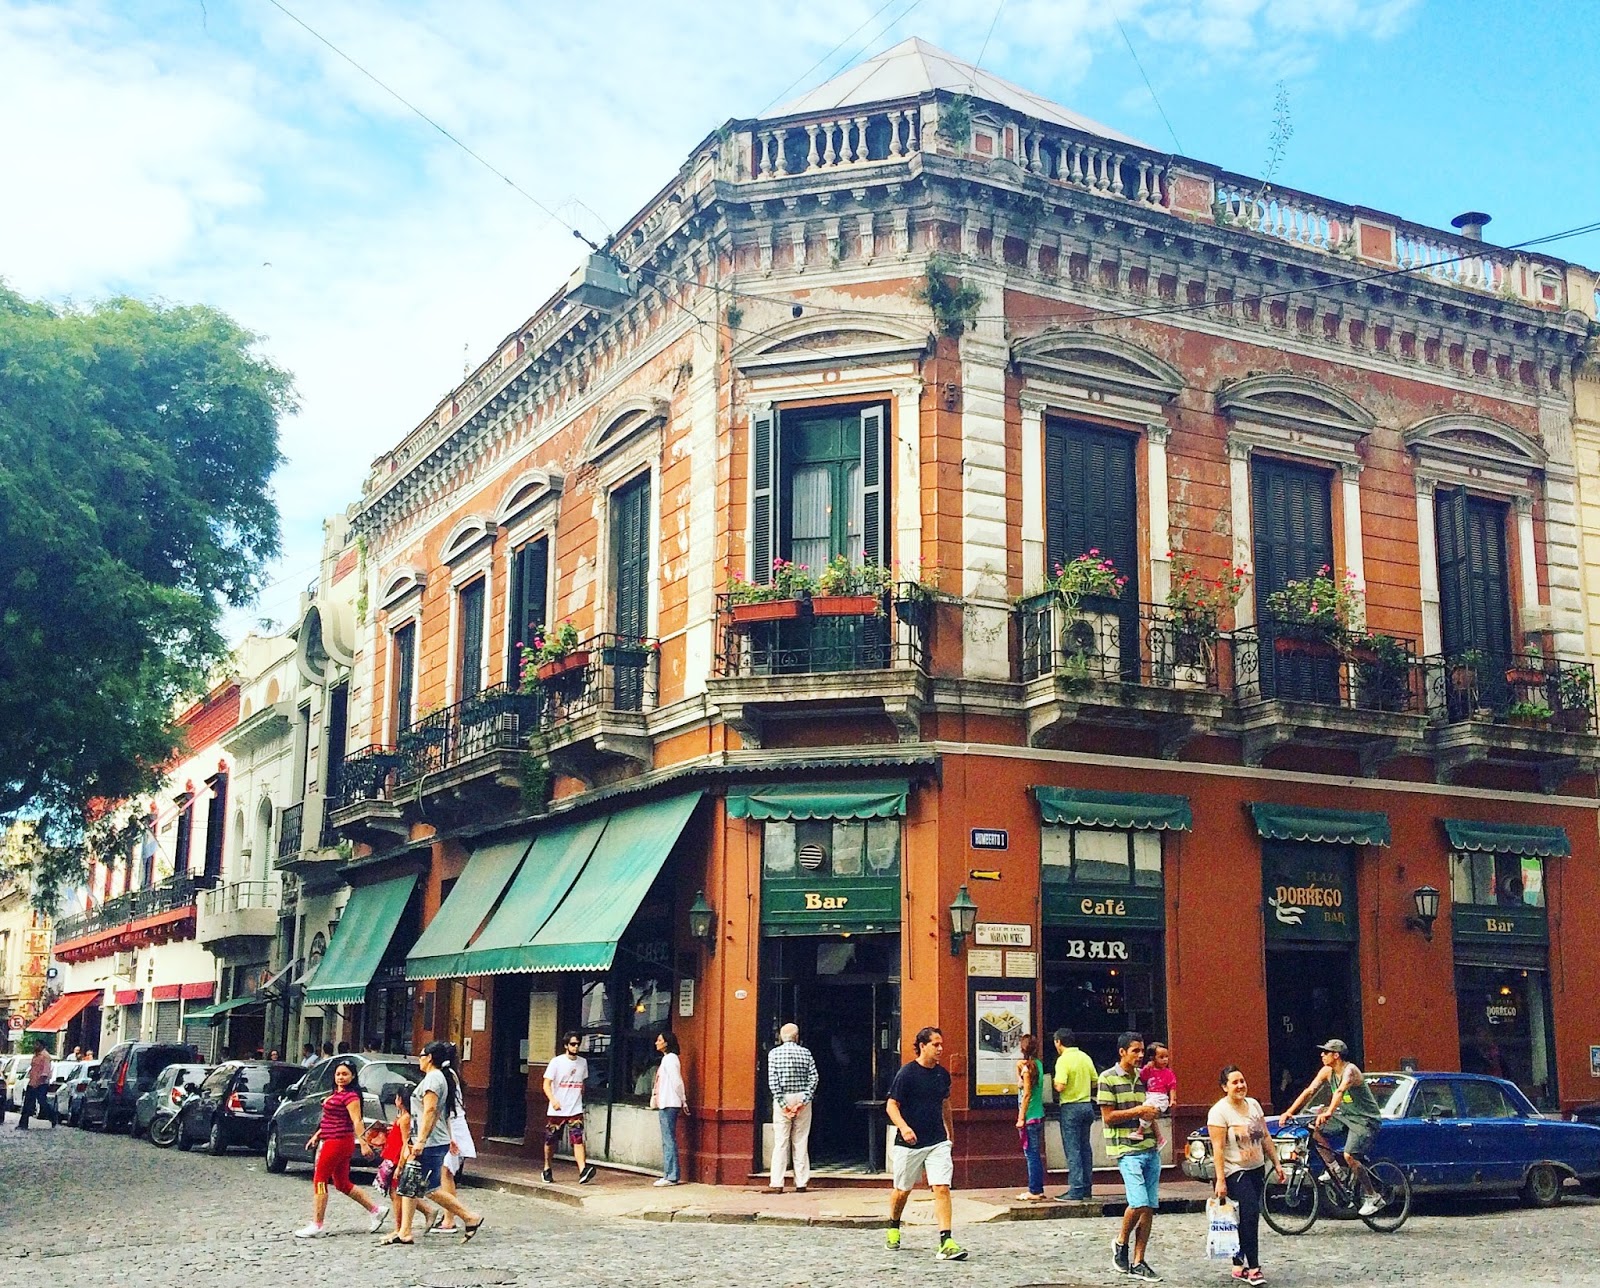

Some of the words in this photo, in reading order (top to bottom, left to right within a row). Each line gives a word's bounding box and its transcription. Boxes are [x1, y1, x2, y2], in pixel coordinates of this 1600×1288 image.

[804, 893, 848, 909] Bar
[1080, 898, 1127, 916] Café
[1323, 911, 1347, 926] BAR
[1485, 918, 1515, 933] Bar
[1066, 939, 1129, 960] BAR
